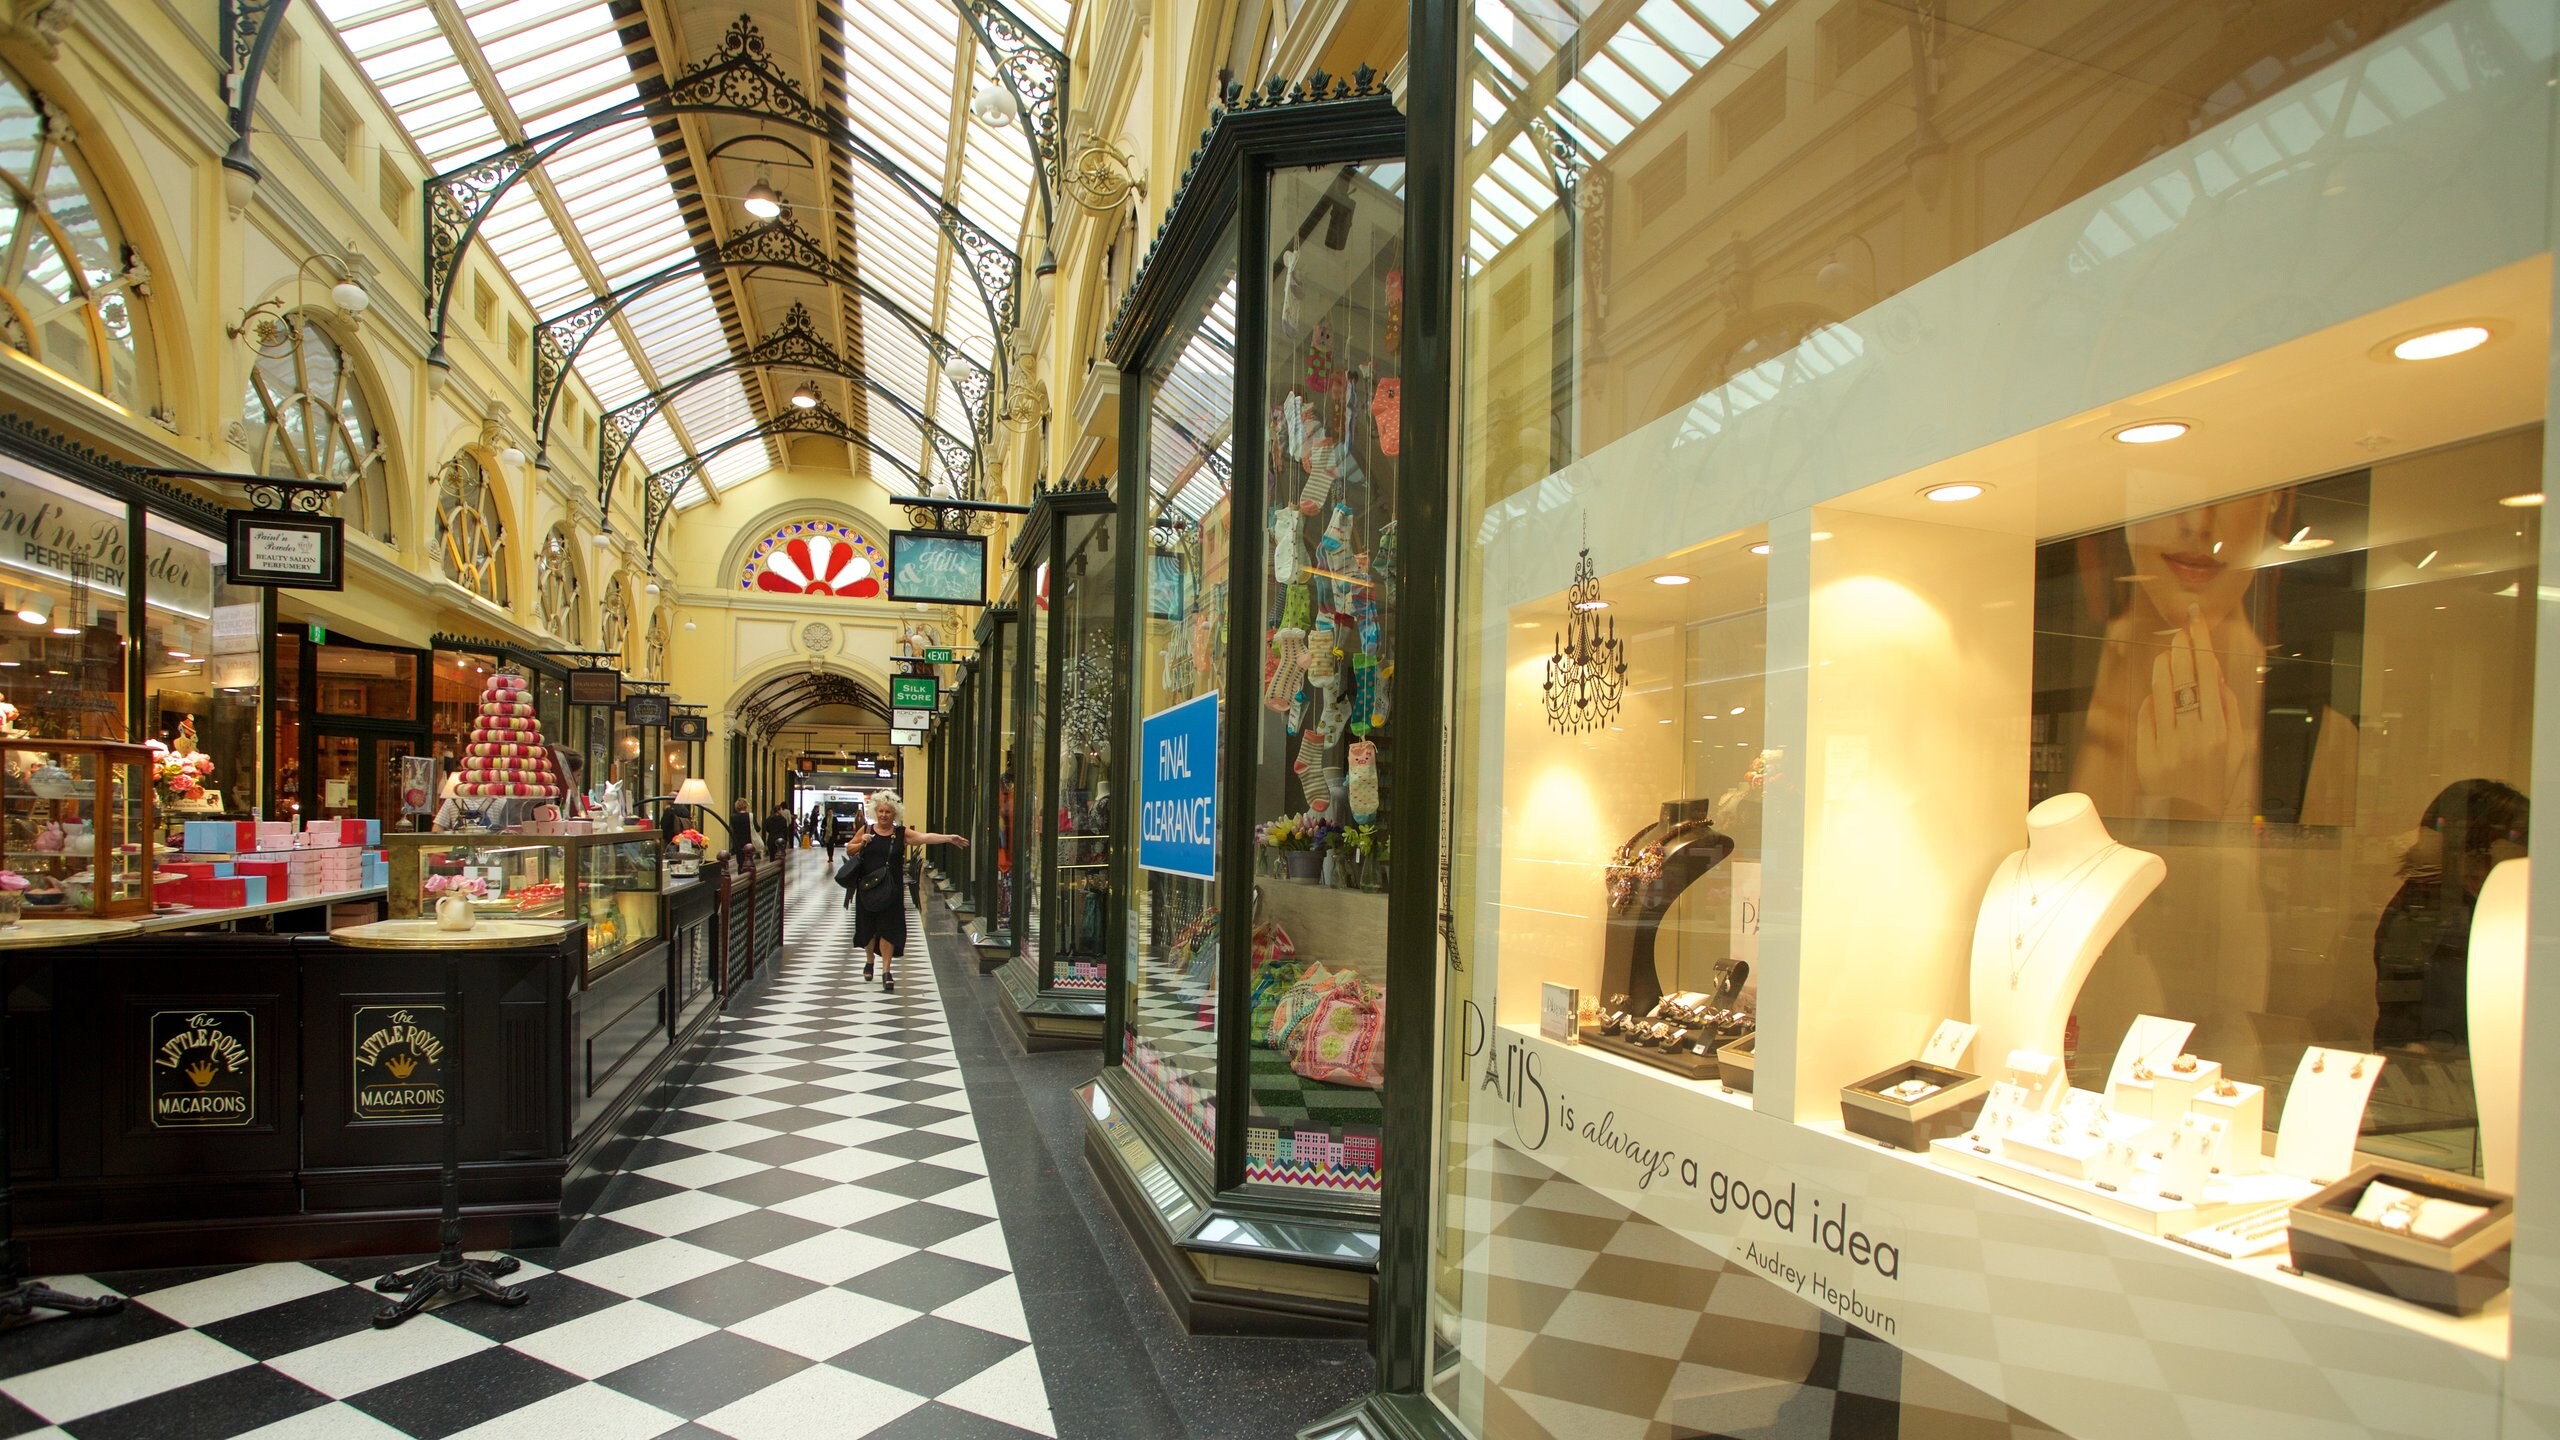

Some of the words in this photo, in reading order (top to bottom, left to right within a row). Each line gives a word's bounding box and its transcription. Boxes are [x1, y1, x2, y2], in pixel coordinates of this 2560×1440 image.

[89, 519, 191, 588] Poder
[256, 554, 288, 562] BEAUTY
[919, 551, 959, 572] Hill
[24, 542, 125, 588] PERFUMERY
[263, 561, 312, 571] PERFUMERY
[931, 651, 950, 661] EXIT
[897, 692, 931, 701] STORE
[902, 684, 926, 693] SILK
[1158, 733, 1191, 782] FINAL
[1143, 796, 1211, 846] CLEARANCE
[185, 1013, 222, 1029] The
[386, 1009, 418, 1024] The
[155, 1029, 208, 1069] LITTLE
[208, 1029, 249, 1072] ROYAL
[356, 1025, 405, 1067] LITTLE
[406, 1025, 444, 1064] ROYAL
[158, 1096, 246, 1114] MACARONS
[361, 1089, 445, 1107] MACARONS
[1560, 1095, 1575, 1132] is
[1582, 1111, 1676, 1190] always
[1681, 1158, 1698, 1188] a
[1710, 1170, 1796, 1233] good
[1812, 1199, 1900, 1281] idea
[1745, 1241, 1807, 1293] Audrey
[1812, 1271, 1896, 1336] Hepburn
